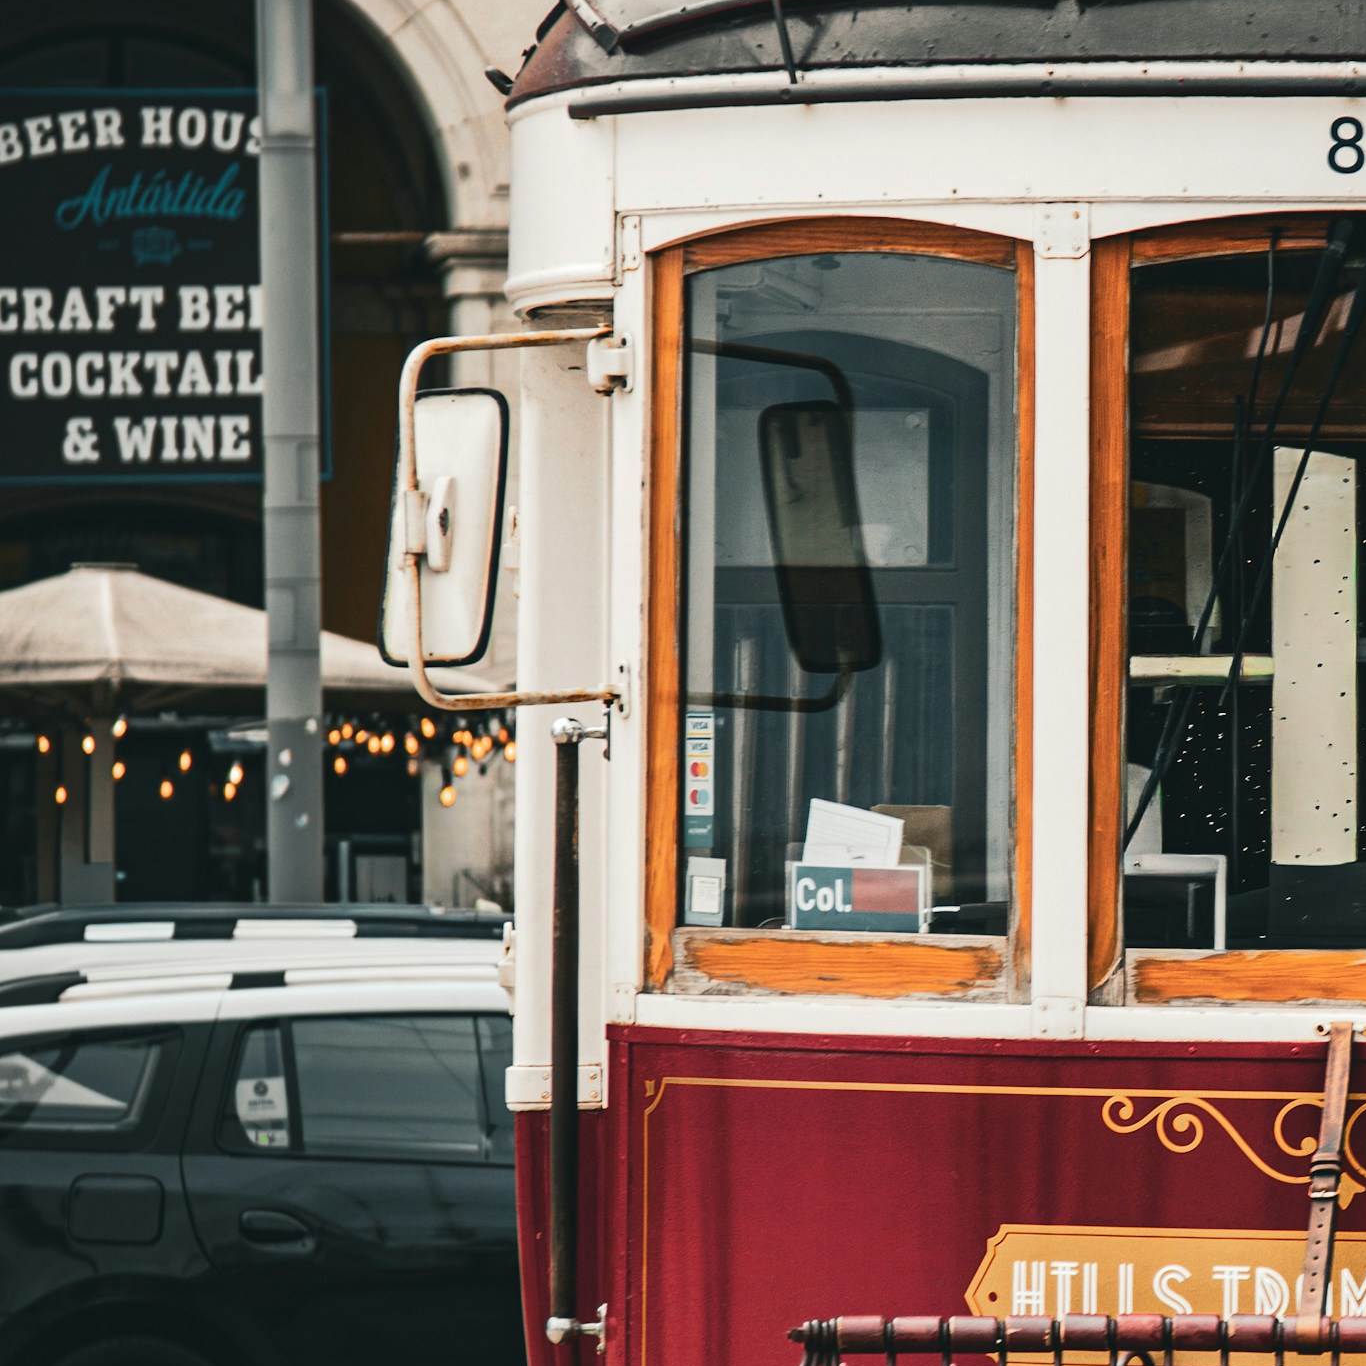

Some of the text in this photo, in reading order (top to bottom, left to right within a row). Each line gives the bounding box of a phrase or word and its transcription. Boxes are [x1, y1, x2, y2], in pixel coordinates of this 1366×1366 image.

[0, 107, 126, 165] BEER
[1327, 116, 1365, 174] 8
[55, 161, 247, 231] Antártida
[0, 285, 164, 332] CRAFT
[63, 415, 251, 463] & WINE
[796, 877, 853, 913] Col.
